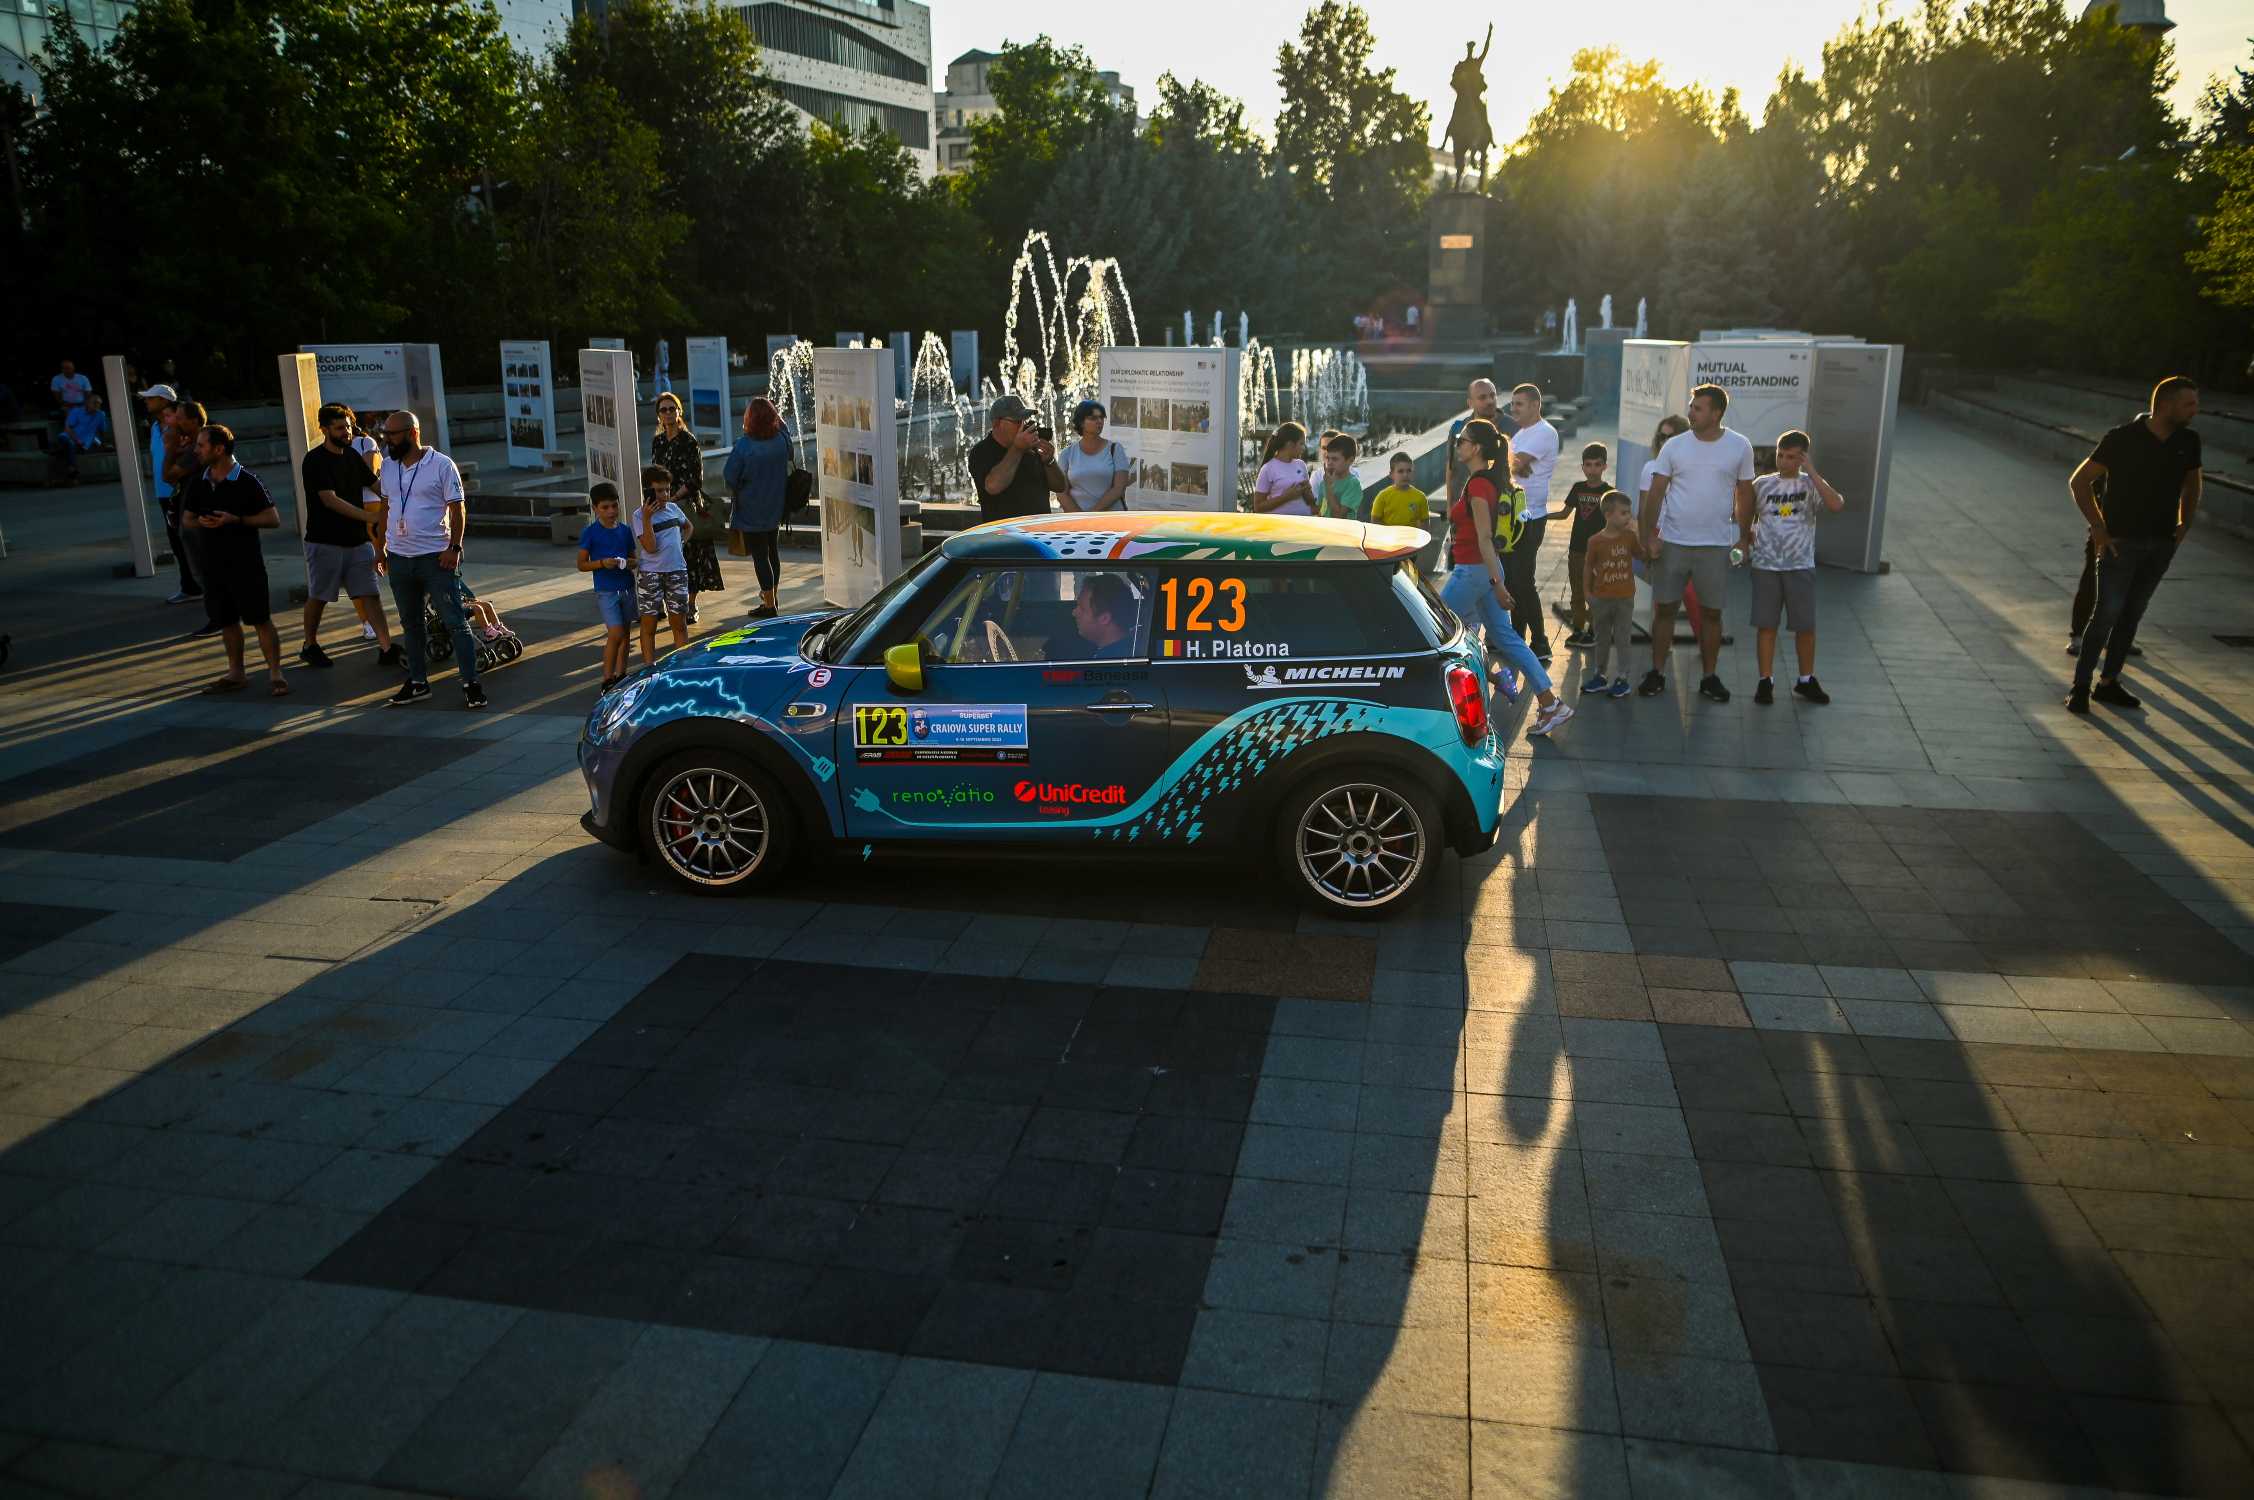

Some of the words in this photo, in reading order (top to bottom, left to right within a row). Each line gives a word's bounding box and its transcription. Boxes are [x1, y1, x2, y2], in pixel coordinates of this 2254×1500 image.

[1150, 369, 1184, 377] RELATIONSHIP
[1697, 362, 1747, 374] MUTUAL
[1697, 375, 1799, 388] UNDERSTANDING
[1160, 577, 1247, 632] 123
[1187, 640, 1206, 657] H.
[1212, 640, 1290, 657] Platona
[813, 670, 827, 683] E
[1285, 666, 1406, 680] MICHELIN
[960, 712, 993, 720] SUPERBET
[856, 707, 907, 745] 123
[931, 723, 967, 734] CRAIOVA
[968, 723, 995, 734] SUPER
[997, 723, 1023, 734] RALLY
[1039, 783, 1127, 804] UniCredit
